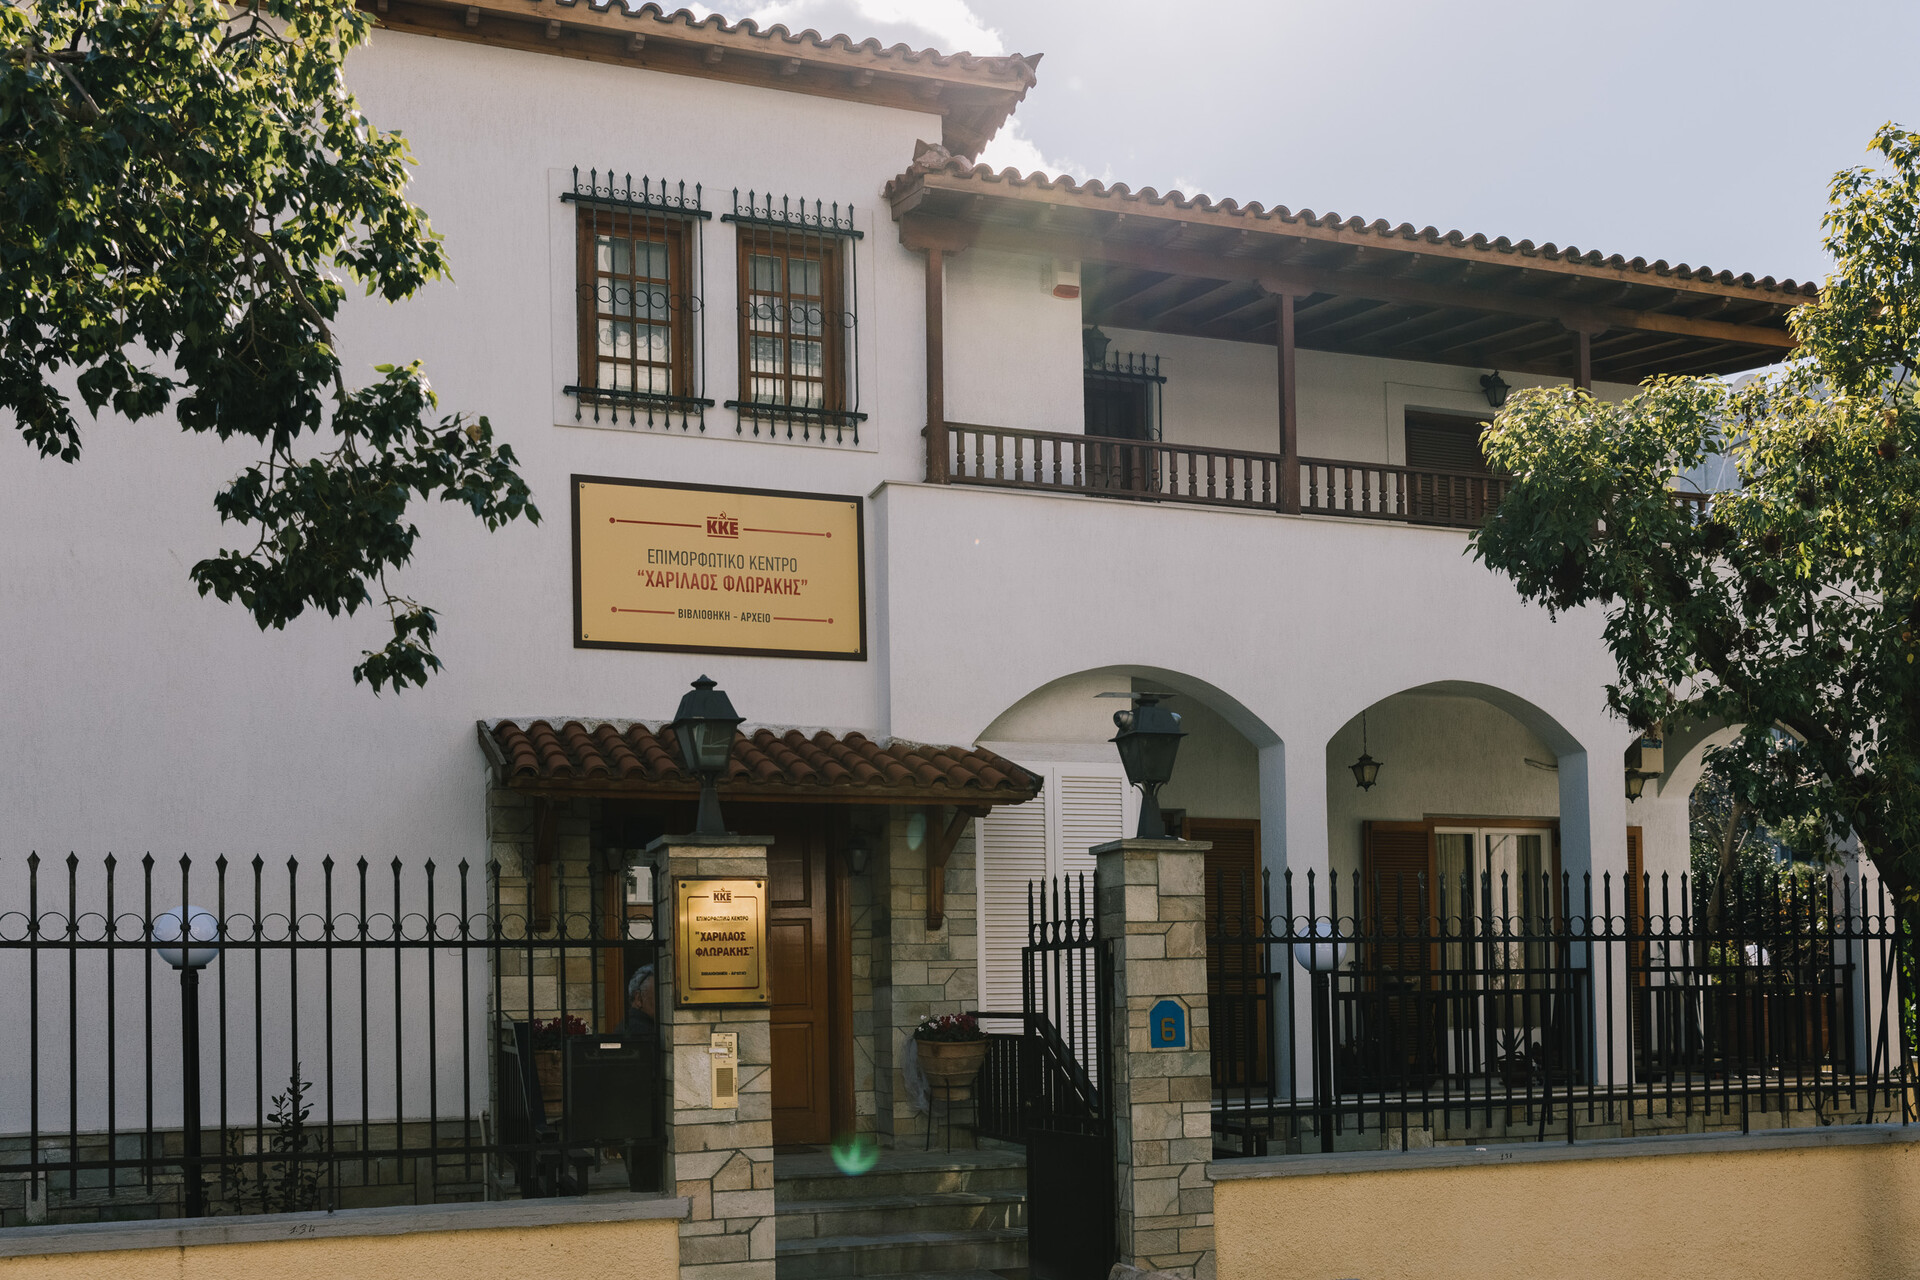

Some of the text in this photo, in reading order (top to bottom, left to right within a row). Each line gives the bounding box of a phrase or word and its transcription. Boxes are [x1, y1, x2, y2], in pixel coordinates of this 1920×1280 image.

[647, 548, 798, 573] ΕΠΙΜΟΡΦΩΤΙΚΟ ΚΕΝΤΡΟ
[677, 608, 731, 621] ΒΙΒΛΙΟΘΗΚΗ
[740, 612, 771, 624] ΑΡΧΕΙΟ
[1161, 1017, 1176, 1042] 6
